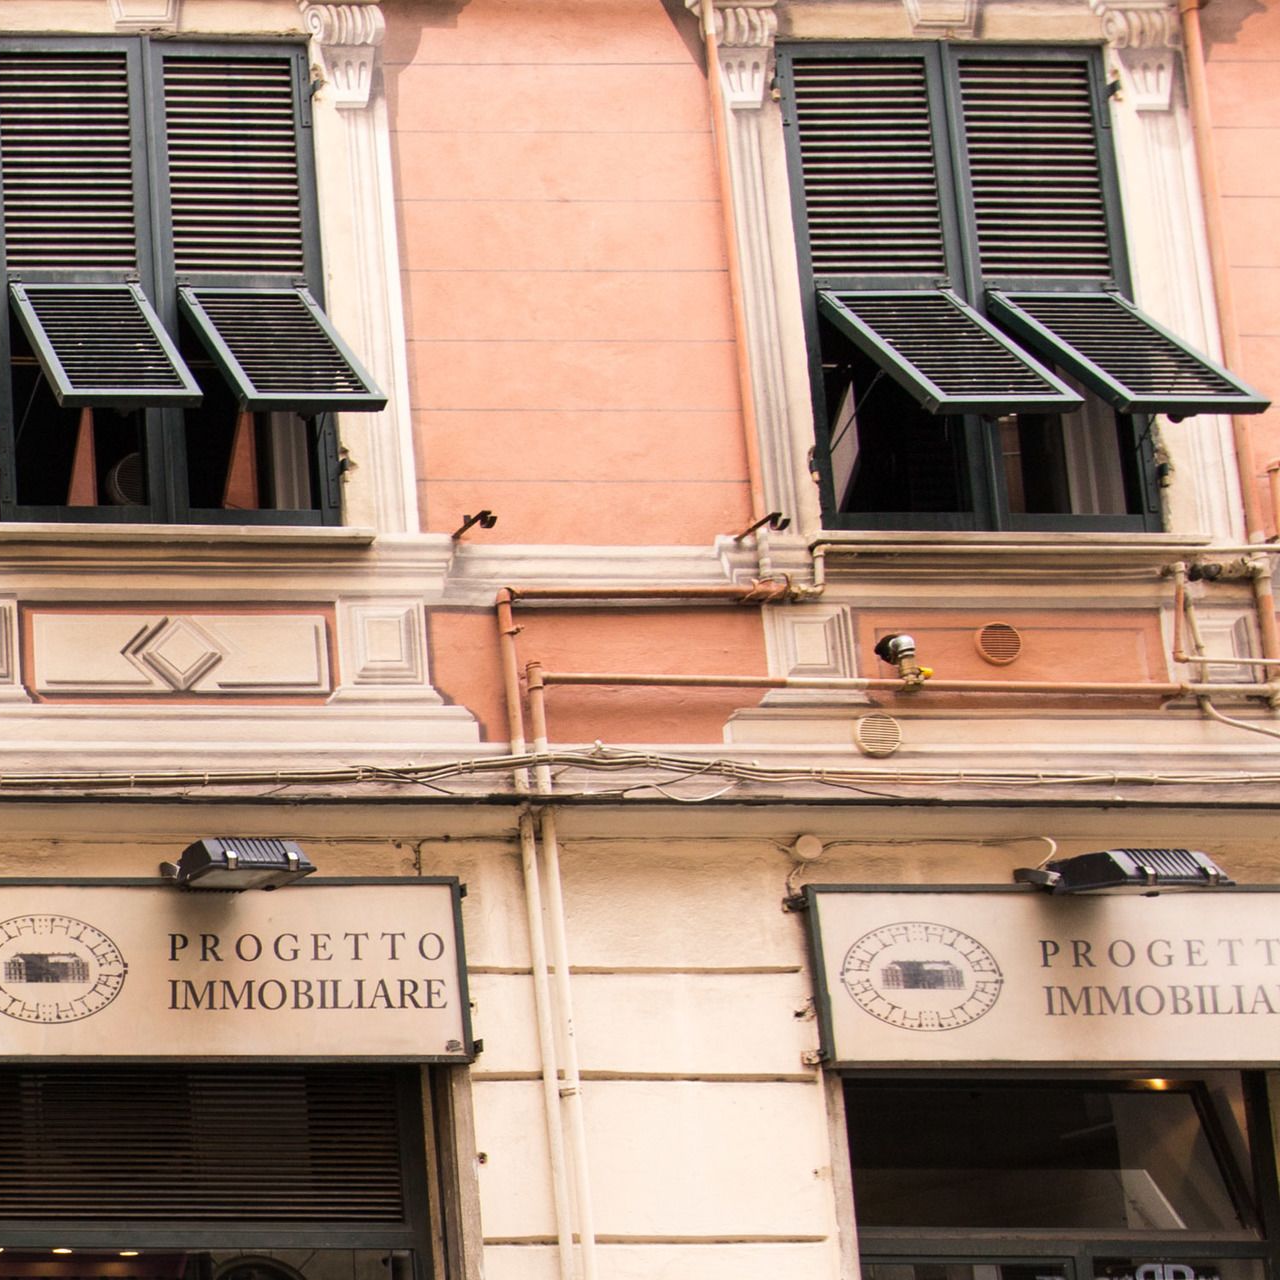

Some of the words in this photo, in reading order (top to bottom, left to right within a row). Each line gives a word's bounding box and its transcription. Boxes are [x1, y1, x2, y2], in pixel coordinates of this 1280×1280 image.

[167, 932, 446, 962] PROGETTO
[1039, 938, 1280, 968] PROGETT
[169, 978, 449, 1010] IMMOBILIARE
[1043, 984, 1280, 1016] IMMOBILIA
